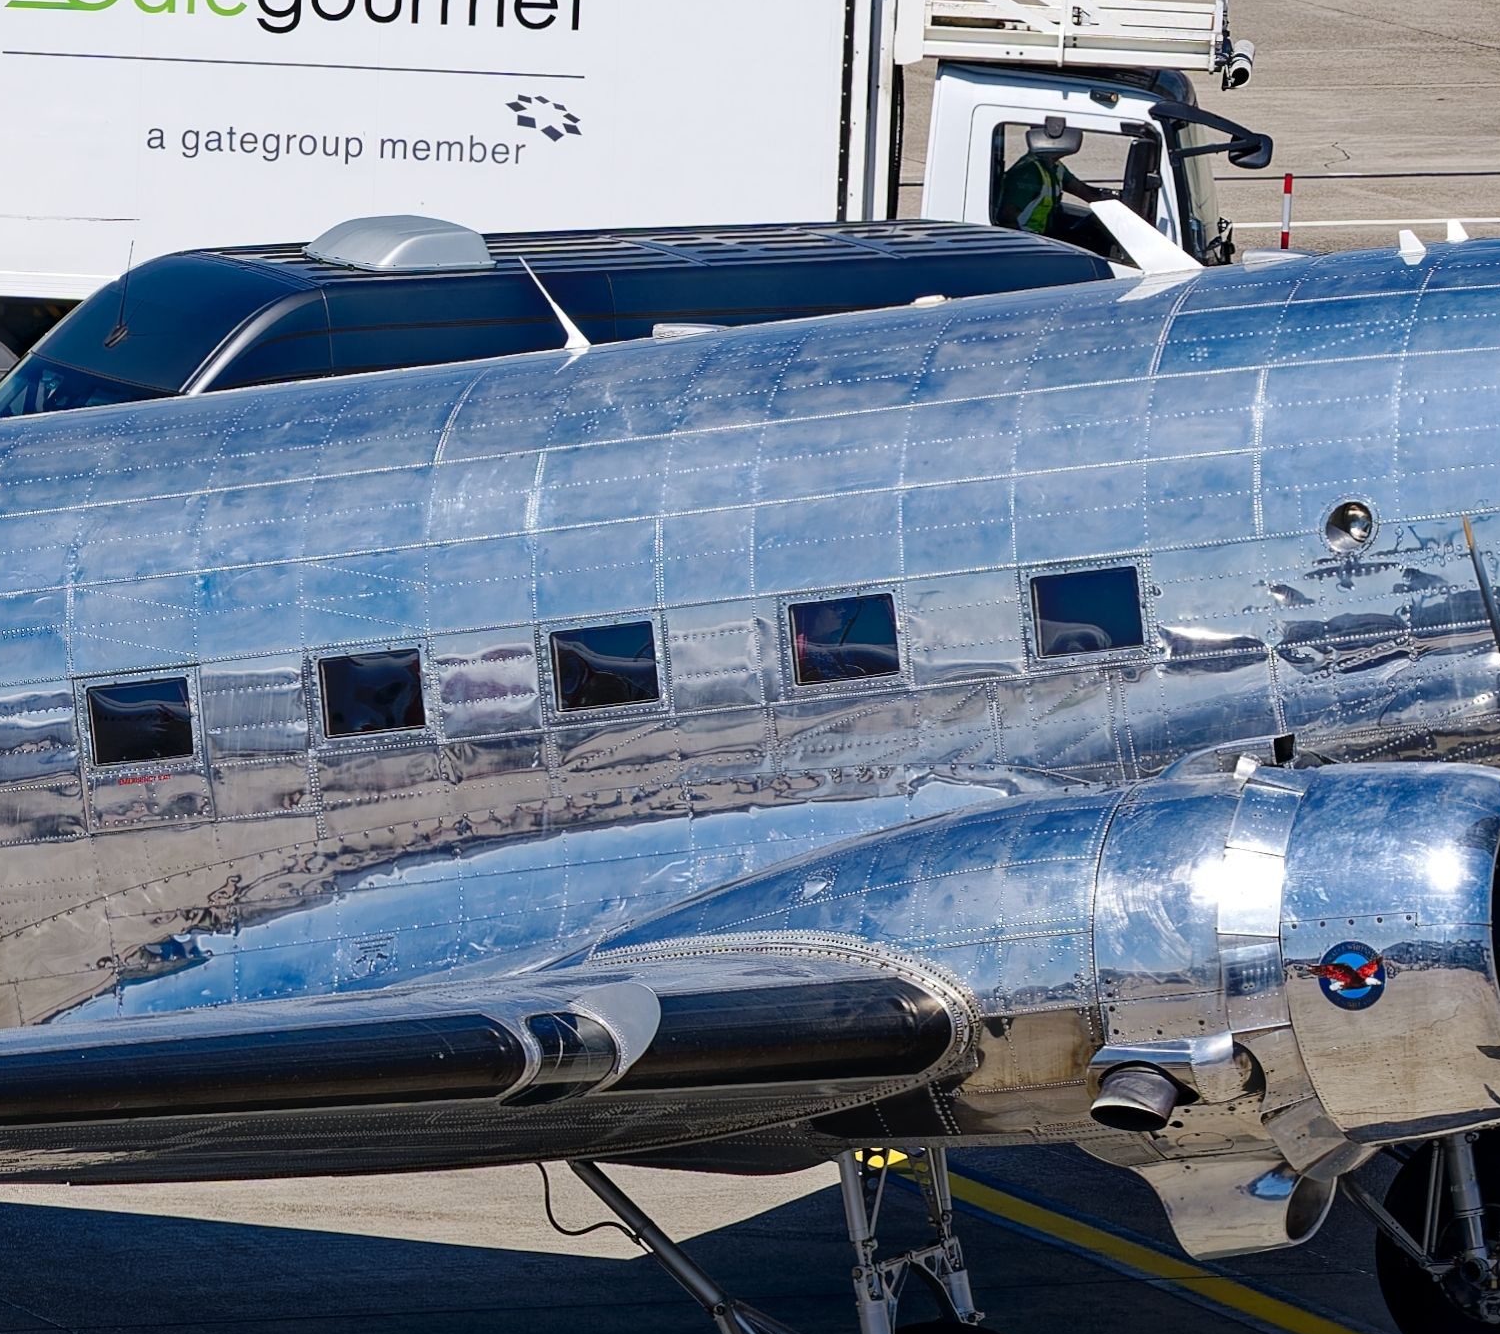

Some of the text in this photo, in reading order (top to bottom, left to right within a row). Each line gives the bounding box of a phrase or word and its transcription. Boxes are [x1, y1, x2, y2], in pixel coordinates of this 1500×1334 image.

[147, 126, 527, 165] a gategroup member
